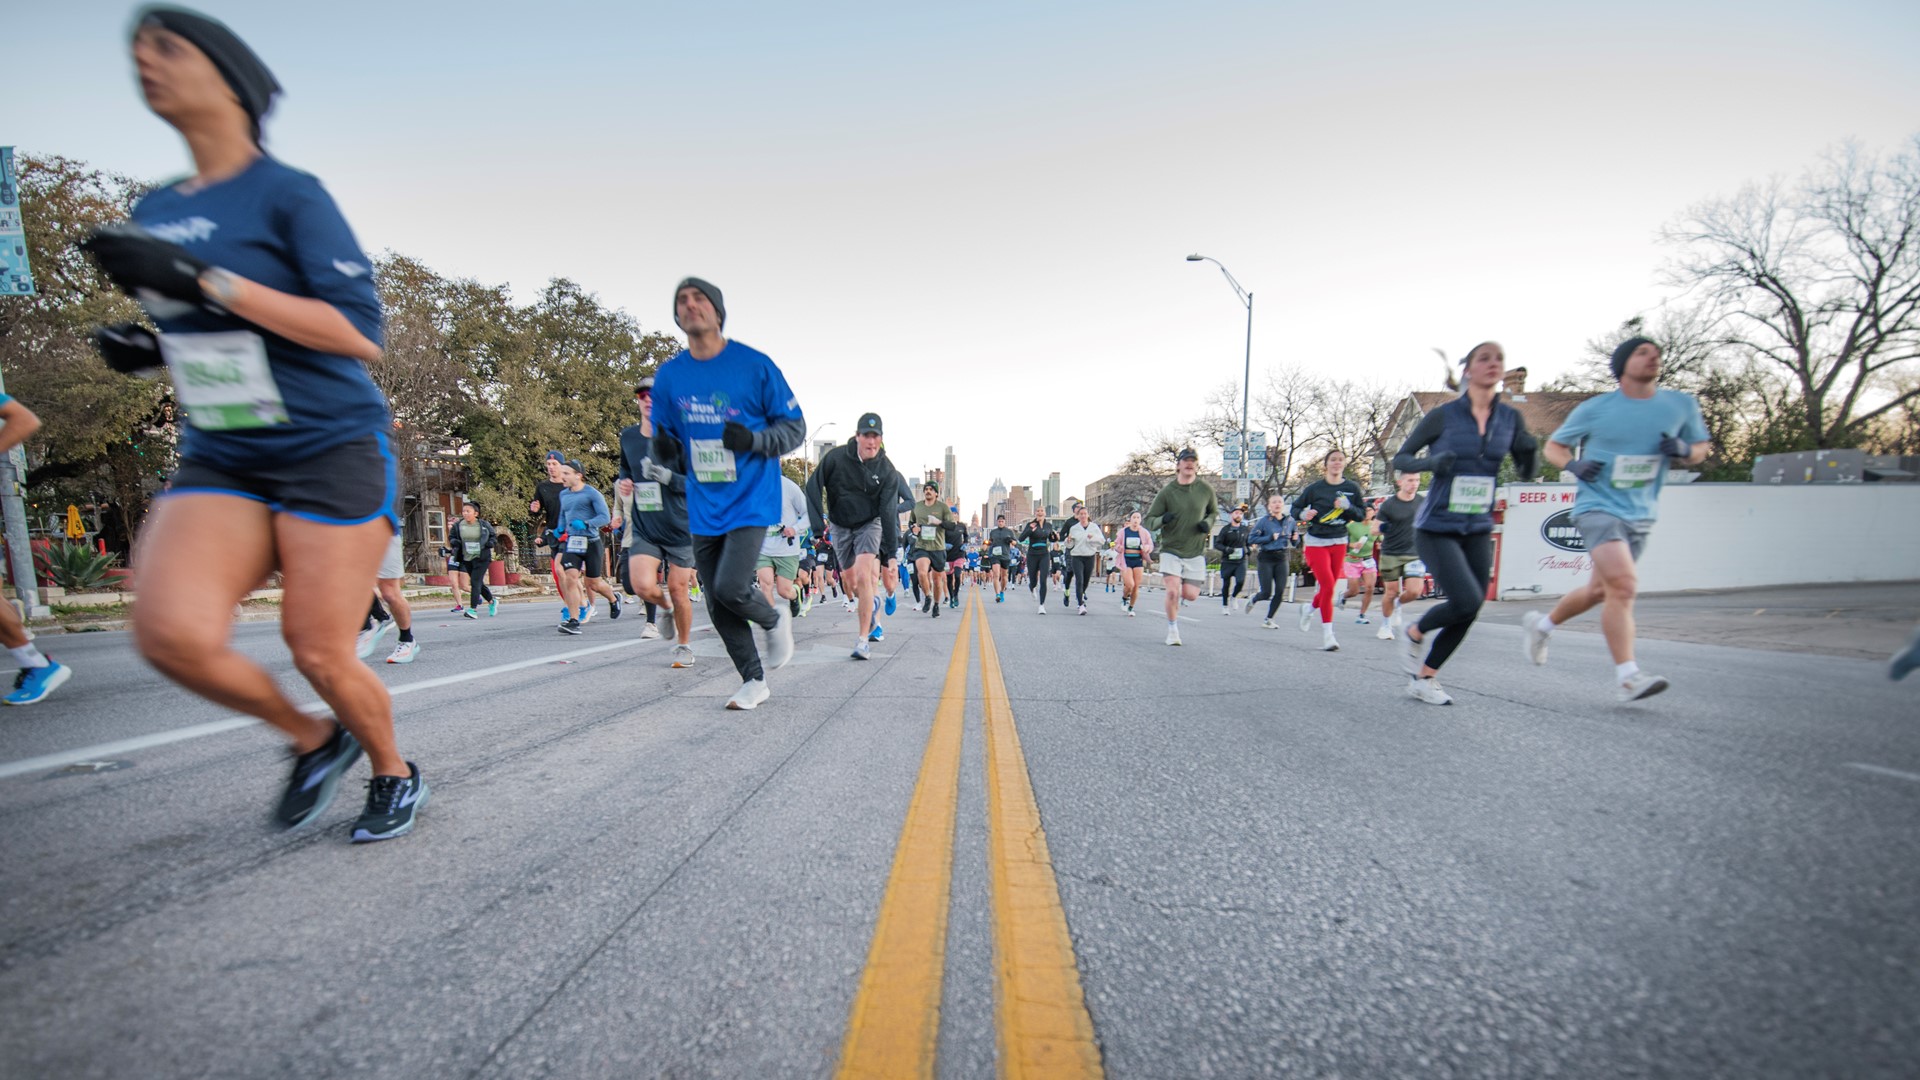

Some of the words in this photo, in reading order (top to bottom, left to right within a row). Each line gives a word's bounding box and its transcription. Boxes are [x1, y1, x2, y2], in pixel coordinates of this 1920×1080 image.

[691, 403, 715, 414] RUN
[687, 413, 721, 425] AUSTIN
[1520, 492, 1547, 503] BEER
[1551, 493, 1557, 502] &
[1538, 555, 1584, 576] Friendly
